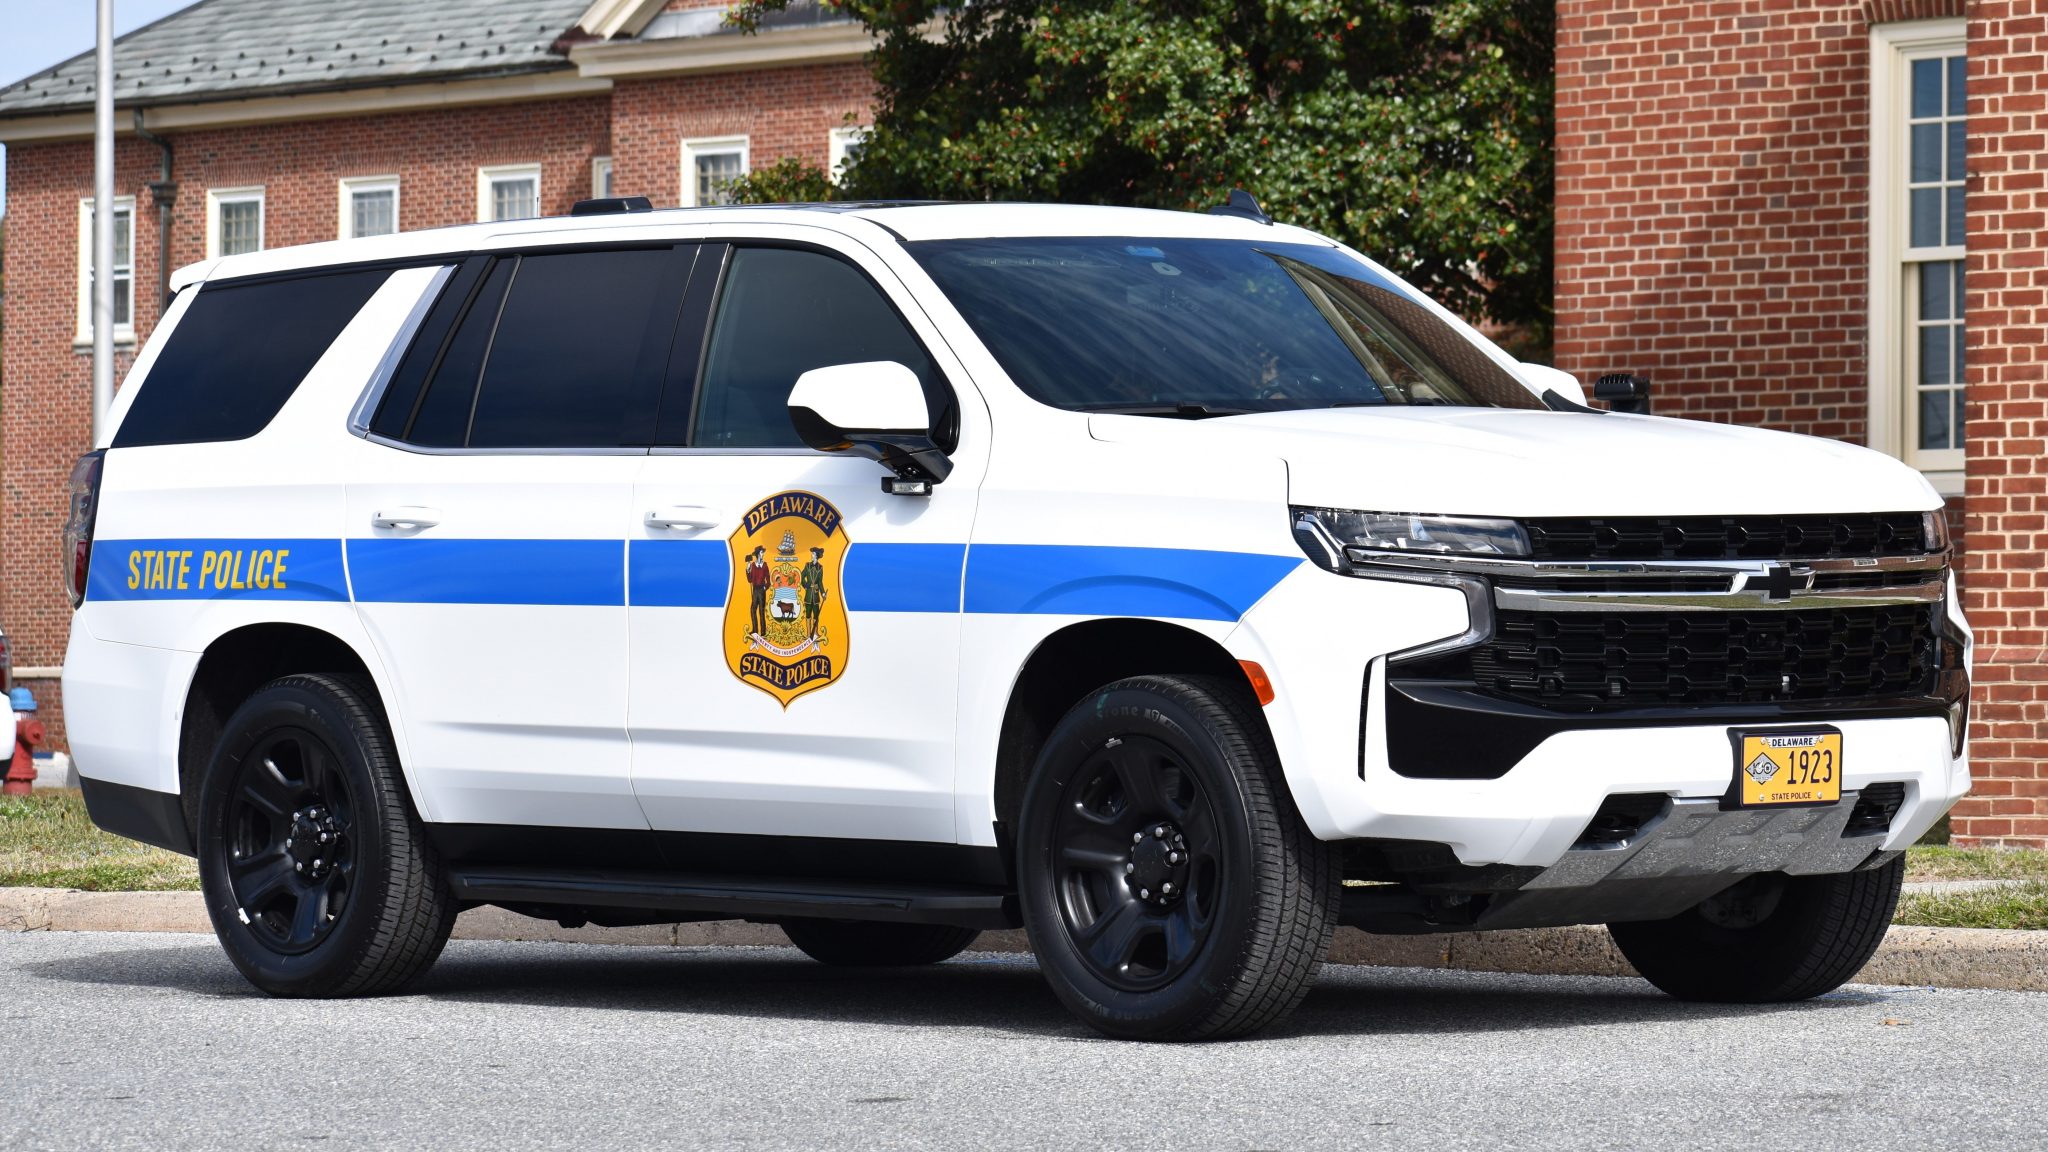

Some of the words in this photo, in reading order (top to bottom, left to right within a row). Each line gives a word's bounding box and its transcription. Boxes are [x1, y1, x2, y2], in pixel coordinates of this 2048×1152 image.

[748, 496, 835, 530] DELAWARE
[127, 550, 193, 590] STATE
[198, 549, 289, 590] POLICE
[742, 656, 783, 685] STATE
[786, 658, 828, 686] POLICE
[1772, 738, 1813, 747] DELAWARE
[1787, 749, 1832, 784] 1923
[1771, 792, 1789, 800] STATE
